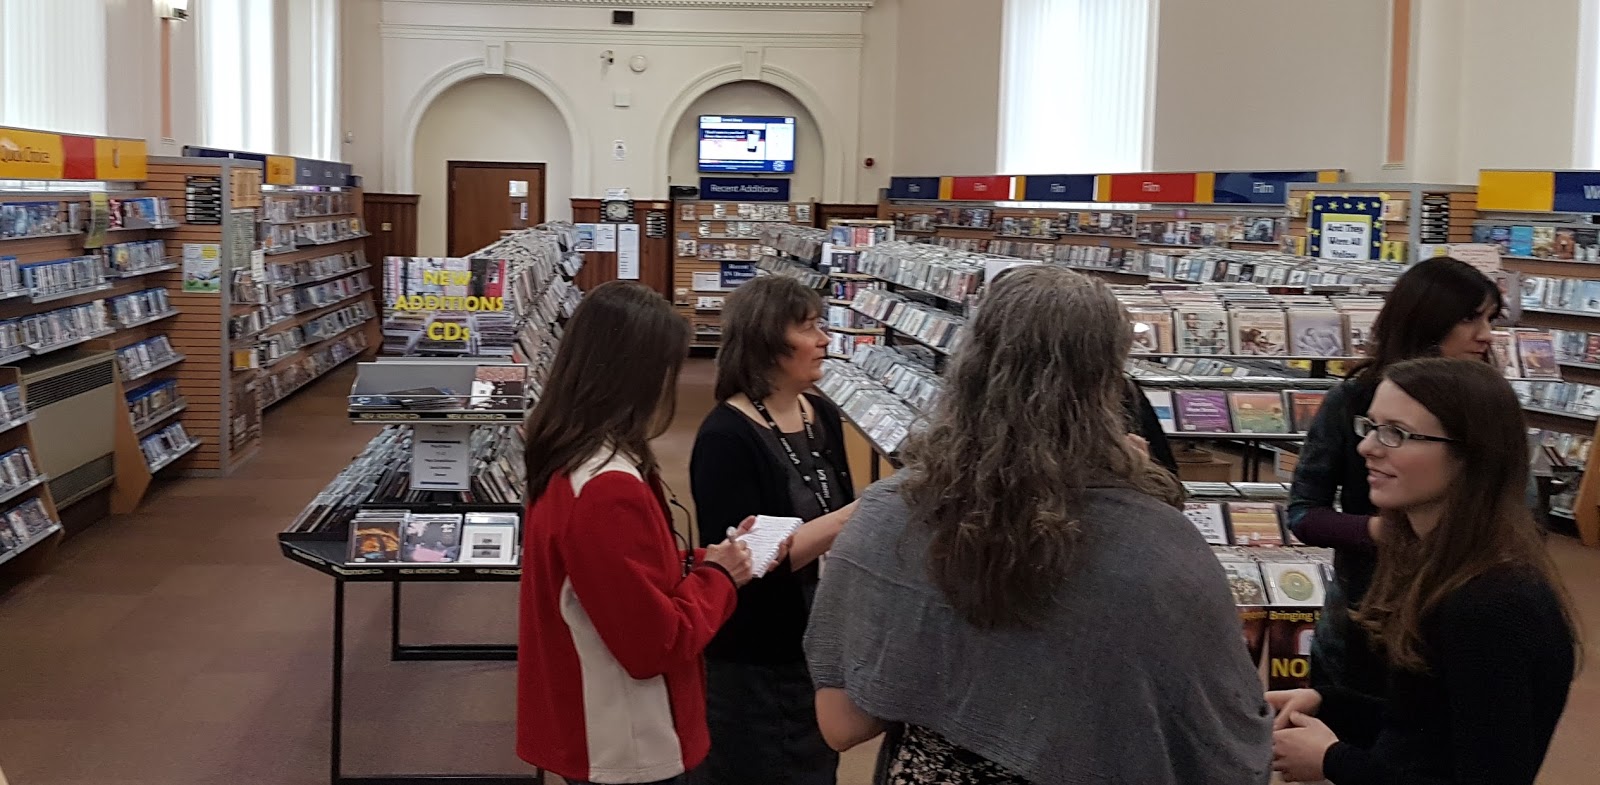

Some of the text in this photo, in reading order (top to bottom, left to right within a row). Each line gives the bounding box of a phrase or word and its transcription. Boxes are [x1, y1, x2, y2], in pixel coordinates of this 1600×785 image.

[709, 184, 779, 193] Recent Additions
[908, 184, 920, 192] Film
[974, 182, 987, 191] Film
[1050, 183, 1066, 192] Film
[1142, 181, 1161, 192] Film
[1253, 181, 1275, 193] Film
[1326, 223, 1364, 234] And They
[1328, 237, 1362, 246] Were All
[1330, 250, 1358, 259] Yellow
[422, 270, 472, 286] NEW
[394, 295, 505, 312] ADDITIONS
[427, 321, 470, 341] CDs
[1269, 610, 1314, 622] Bringing
